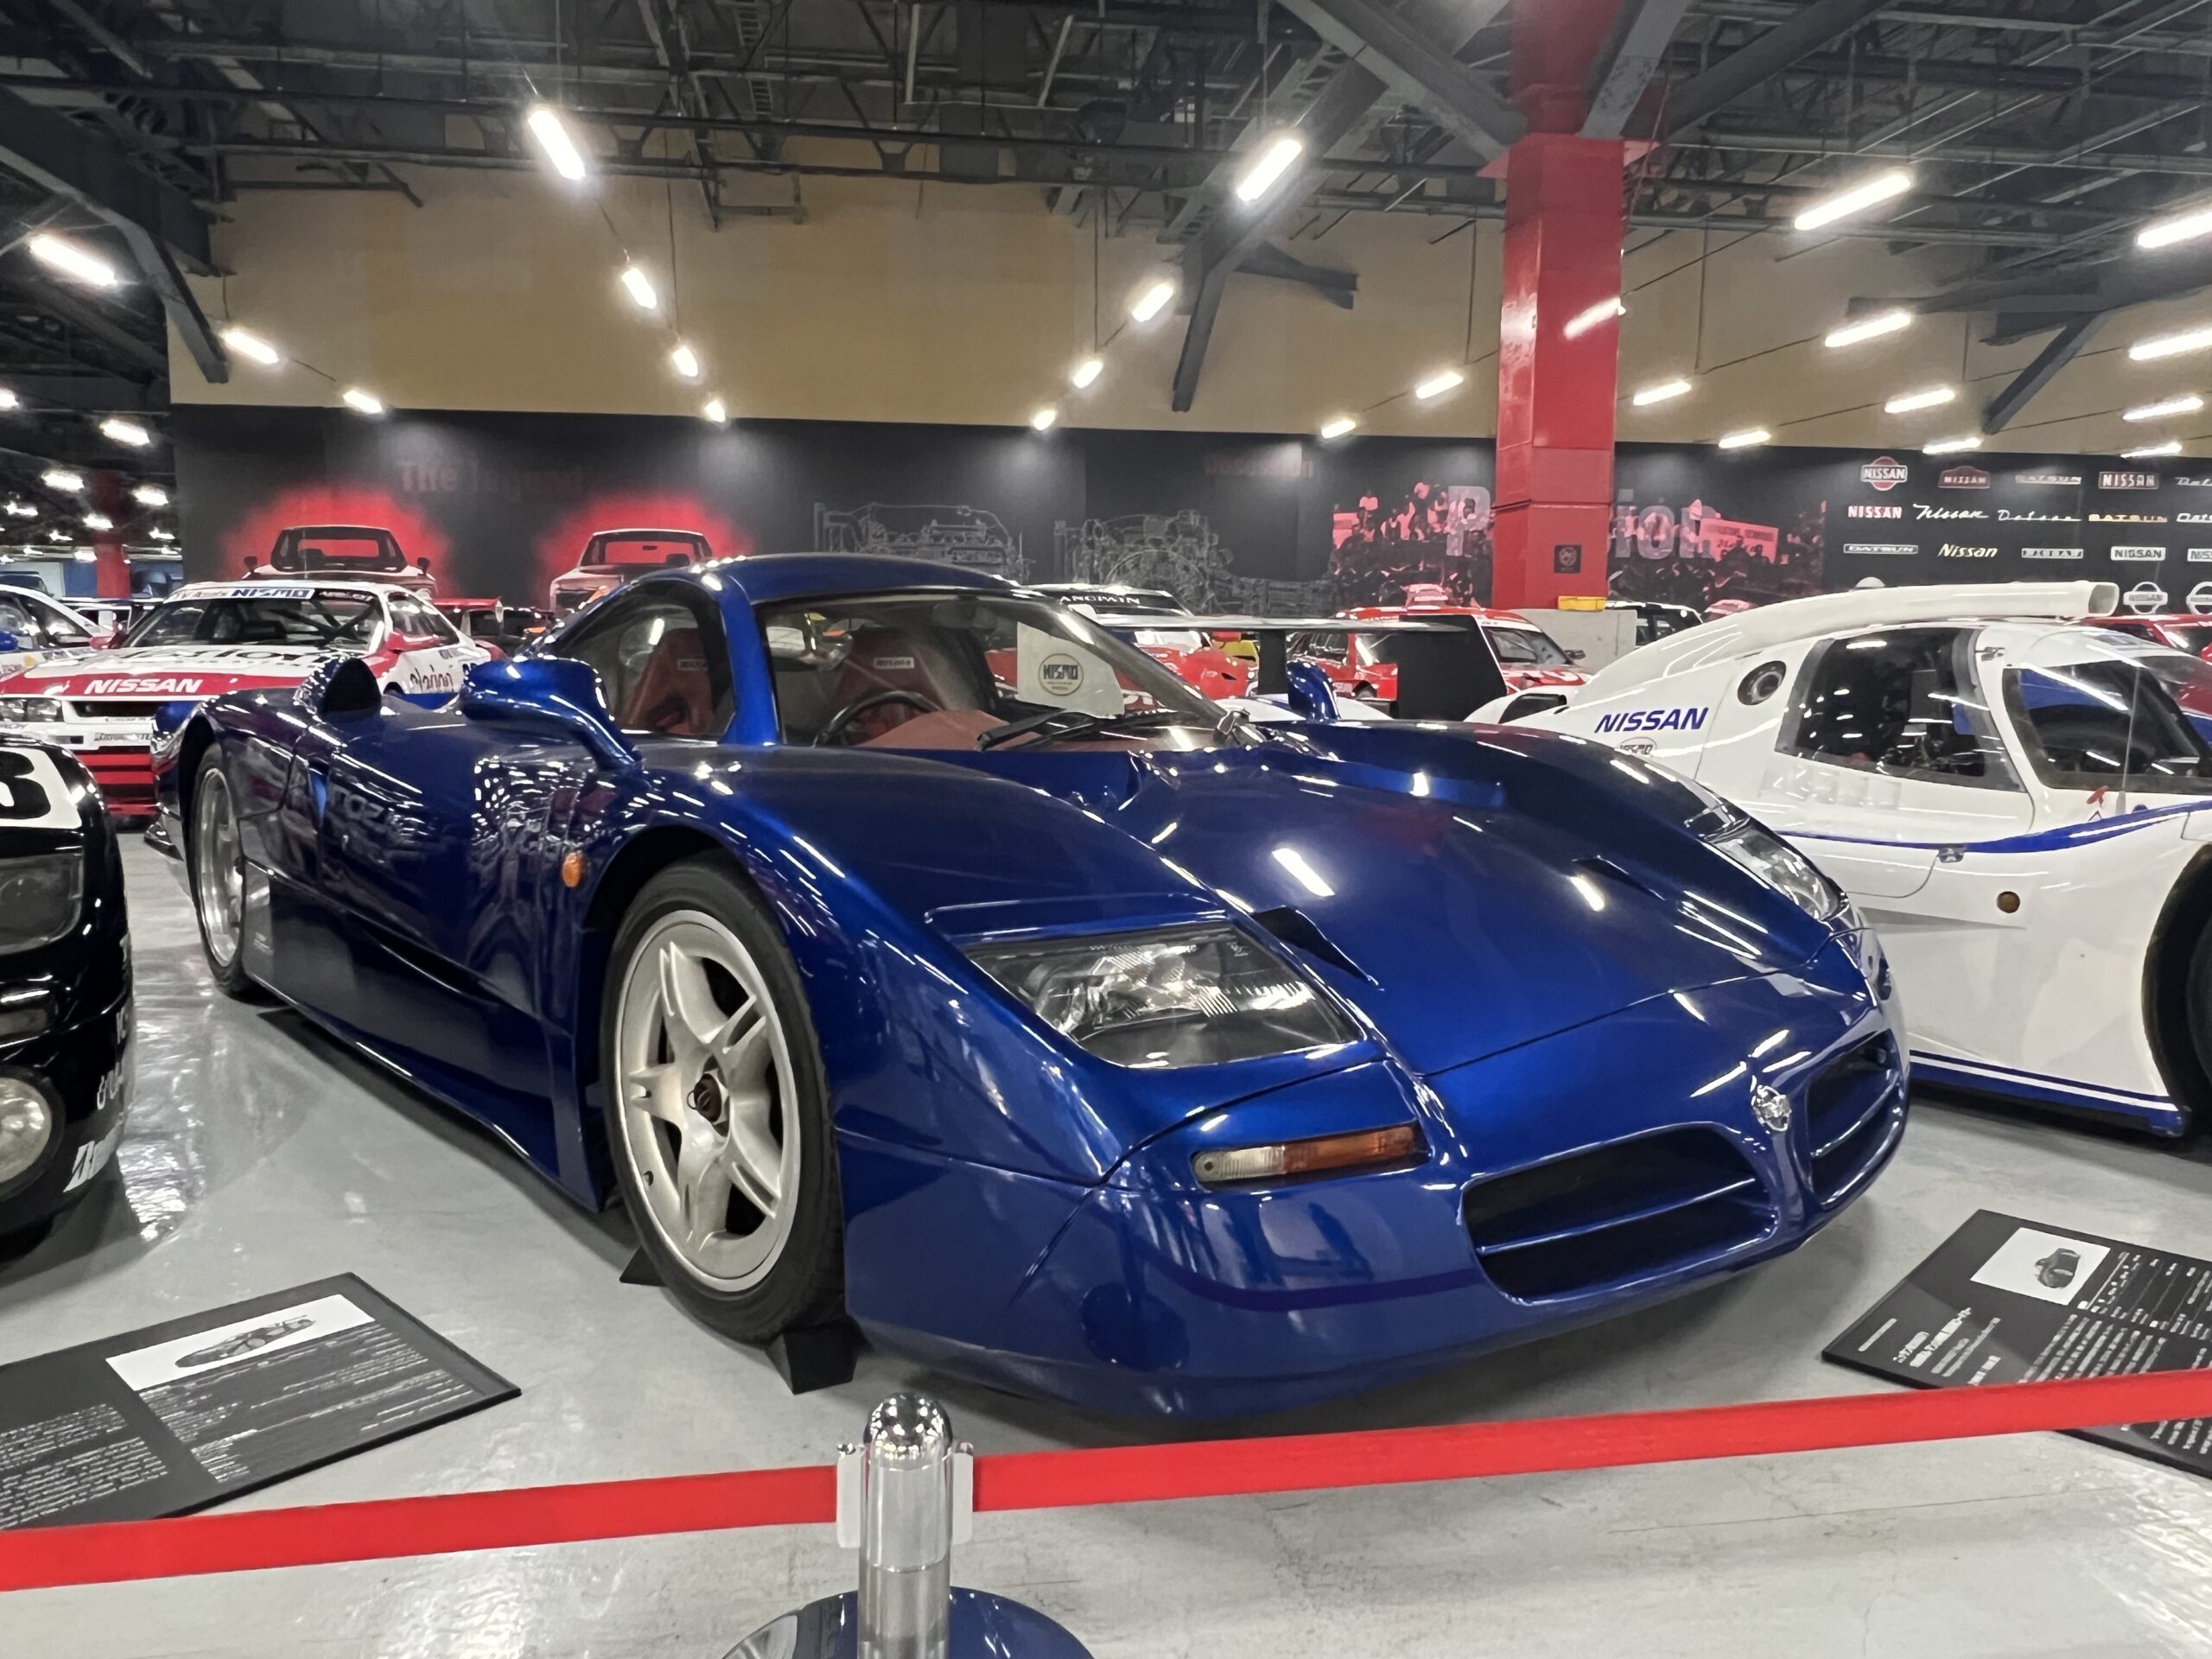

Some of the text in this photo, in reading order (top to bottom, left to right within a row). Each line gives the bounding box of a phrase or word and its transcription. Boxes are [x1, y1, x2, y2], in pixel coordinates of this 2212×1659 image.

[1864, 467, 1906, 480] NISSAN
[2102, 474, 2156, 487] NISSAN
[1847, 505, 1903, 518] NISSAN
[1937, 543, 1999, 557] Nissan
[2114, 550, 2162, 558] NISSAN
[231, 588, 310, 598] NISMO
[84, 678, 203, 695] NISSAN
[1594, 707, 1709, 733] NISSAN
